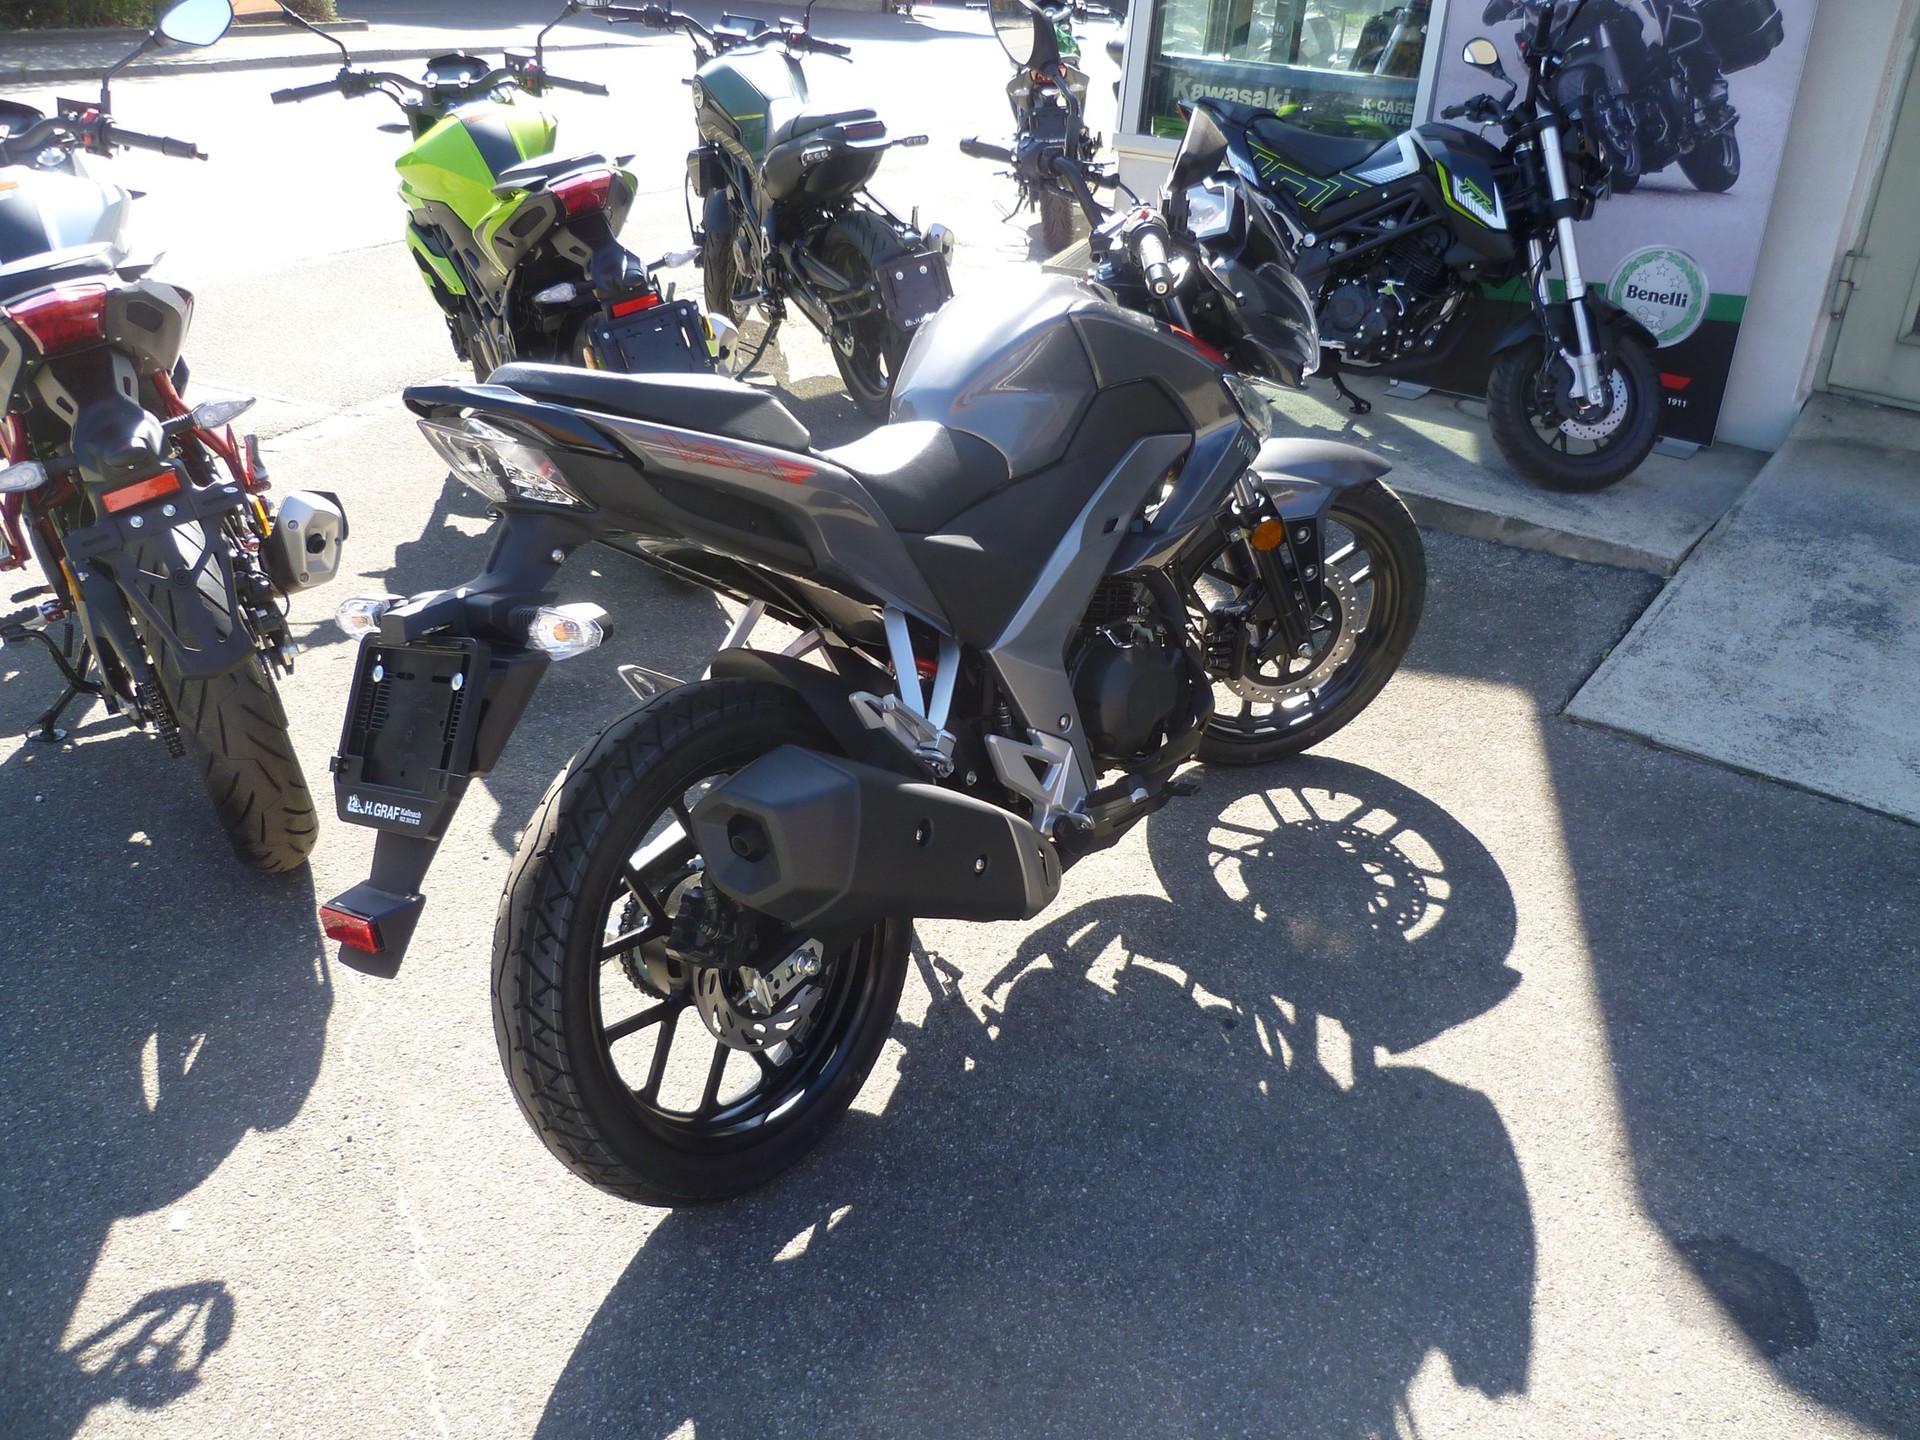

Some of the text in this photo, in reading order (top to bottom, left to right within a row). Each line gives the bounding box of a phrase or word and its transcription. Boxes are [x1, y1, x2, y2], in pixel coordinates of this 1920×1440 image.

[1173, 76, 1291, 109] Kawasaki
[1626, 284, 1688, 308] Benelli
[1667, 397, 1687, 408] 1911
